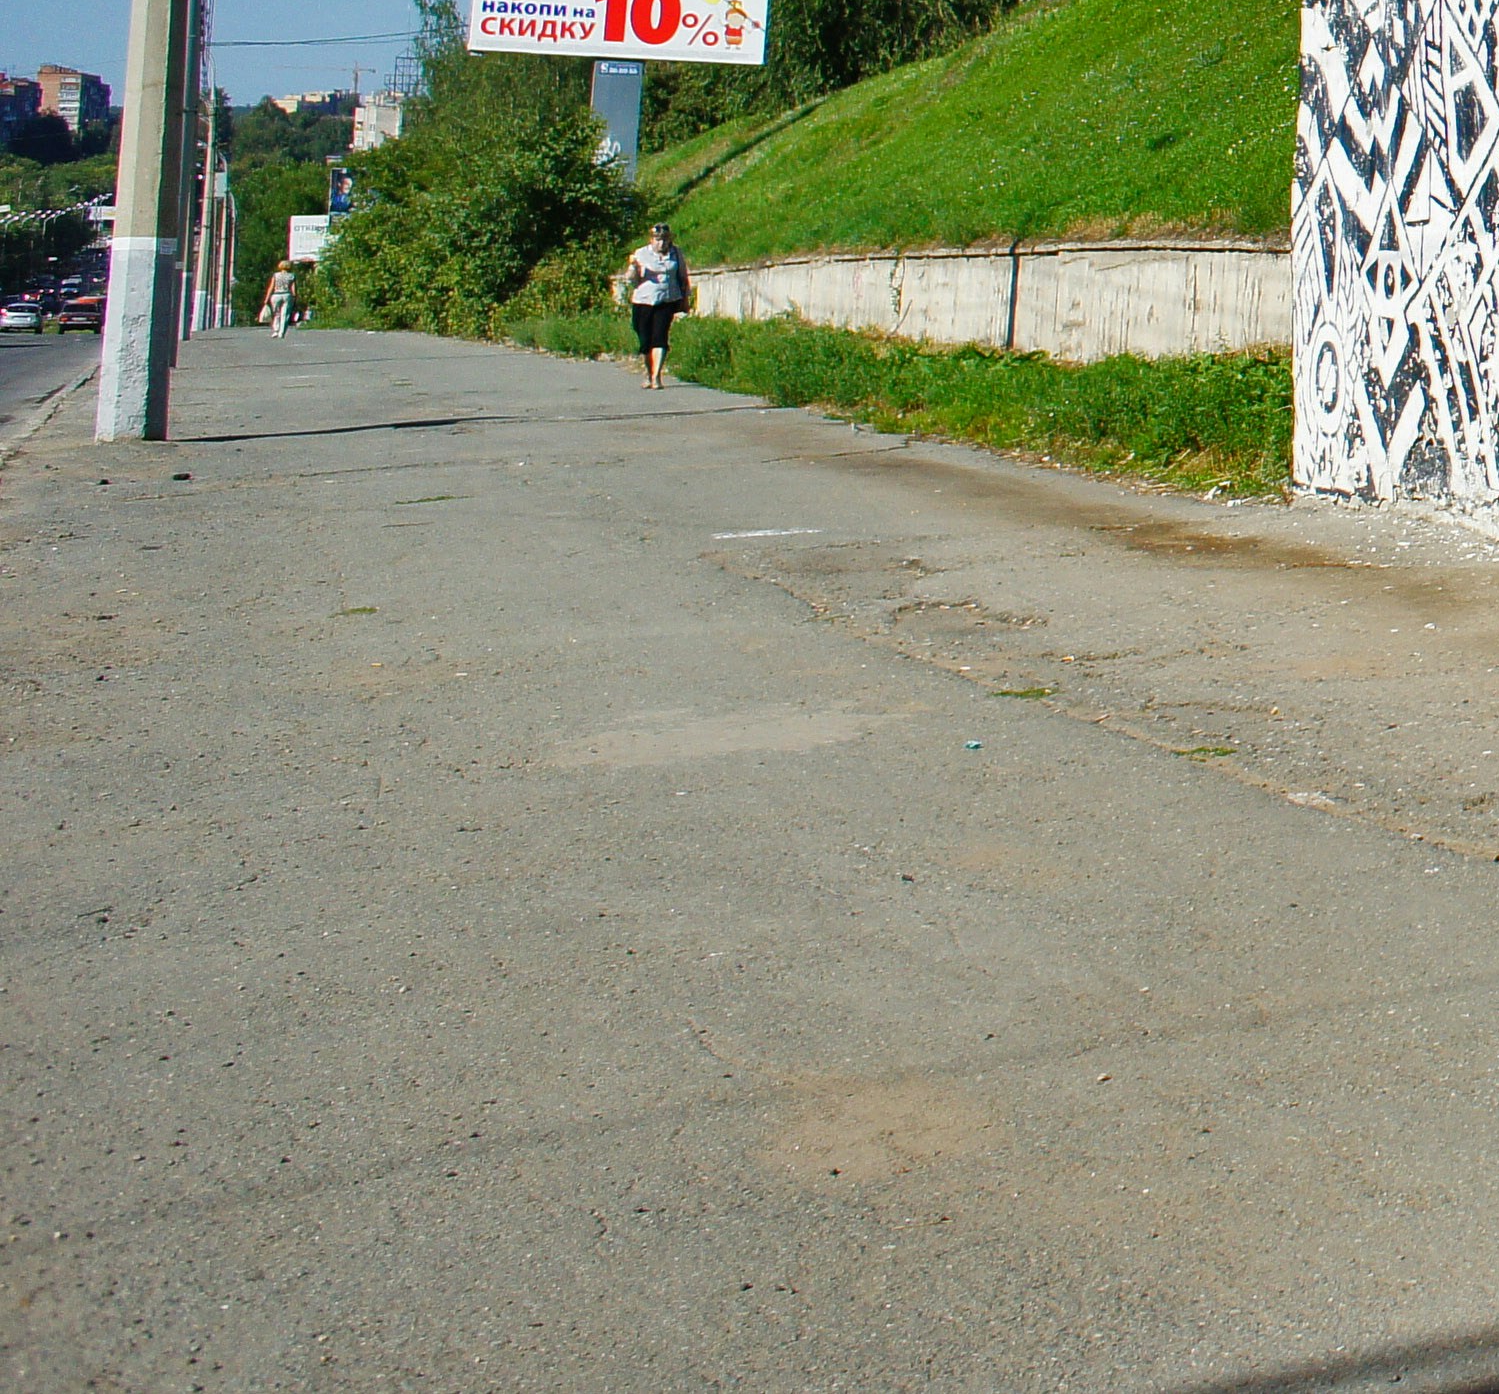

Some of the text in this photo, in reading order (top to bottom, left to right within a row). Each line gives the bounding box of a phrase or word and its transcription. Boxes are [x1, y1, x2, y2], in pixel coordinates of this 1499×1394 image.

[481, 0, 596, 19] накопи на
[480, 17, 596, 42] СКИДКУ
